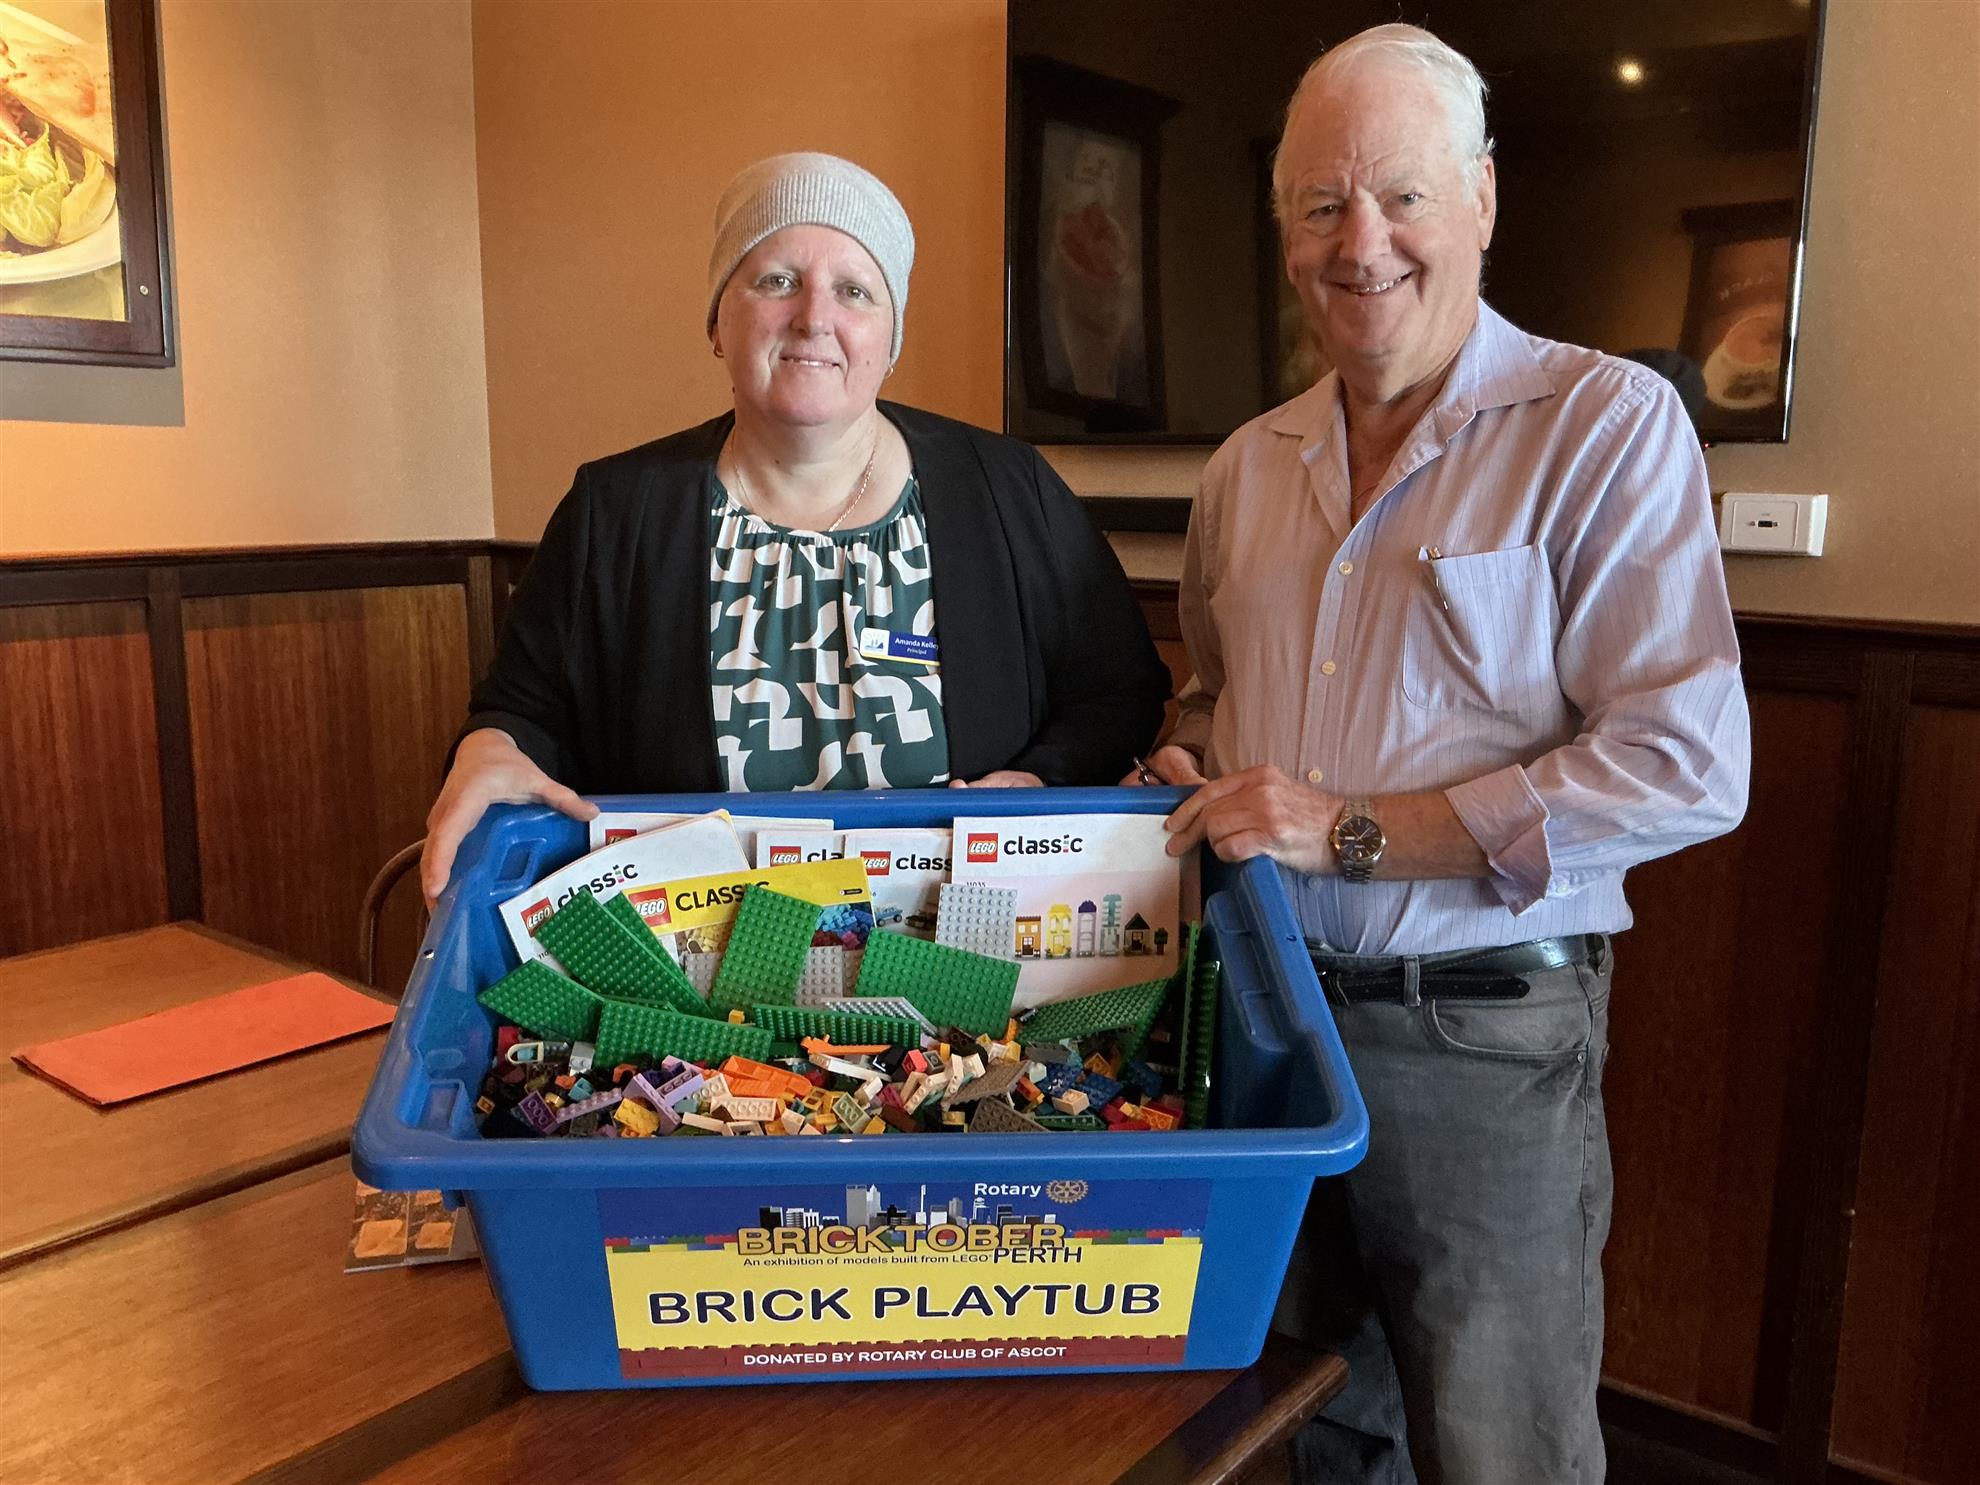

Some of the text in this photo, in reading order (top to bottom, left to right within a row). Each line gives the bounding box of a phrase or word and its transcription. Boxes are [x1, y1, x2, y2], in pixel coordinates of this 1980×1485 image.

[895, 637, 920, 647] Amanda
[970, 834, 1083, 855] LEGO classic
[773, 854, 799, 863] LEGO
[528, 907, 550, 928] LEGO
[974, 1183, 1041, 1197] Rotary
[744, 1258, 760, 1266] An
[764, 1256, 823, 1266] exhibition
[827, 1256, 839, 1265] of
[843, 1255, 888, 1265] models
[891, 1255, 917, 1263] built
[921, 1255, 949, 1263] from
[993, 1247, 1082, 1263] PERTH
[650, 1284, 1160, 1324] BRICK PLAYTUB
[743, 1346, 1067, 1365] DONATED BY ROTARY CLUB OF ASCOT
